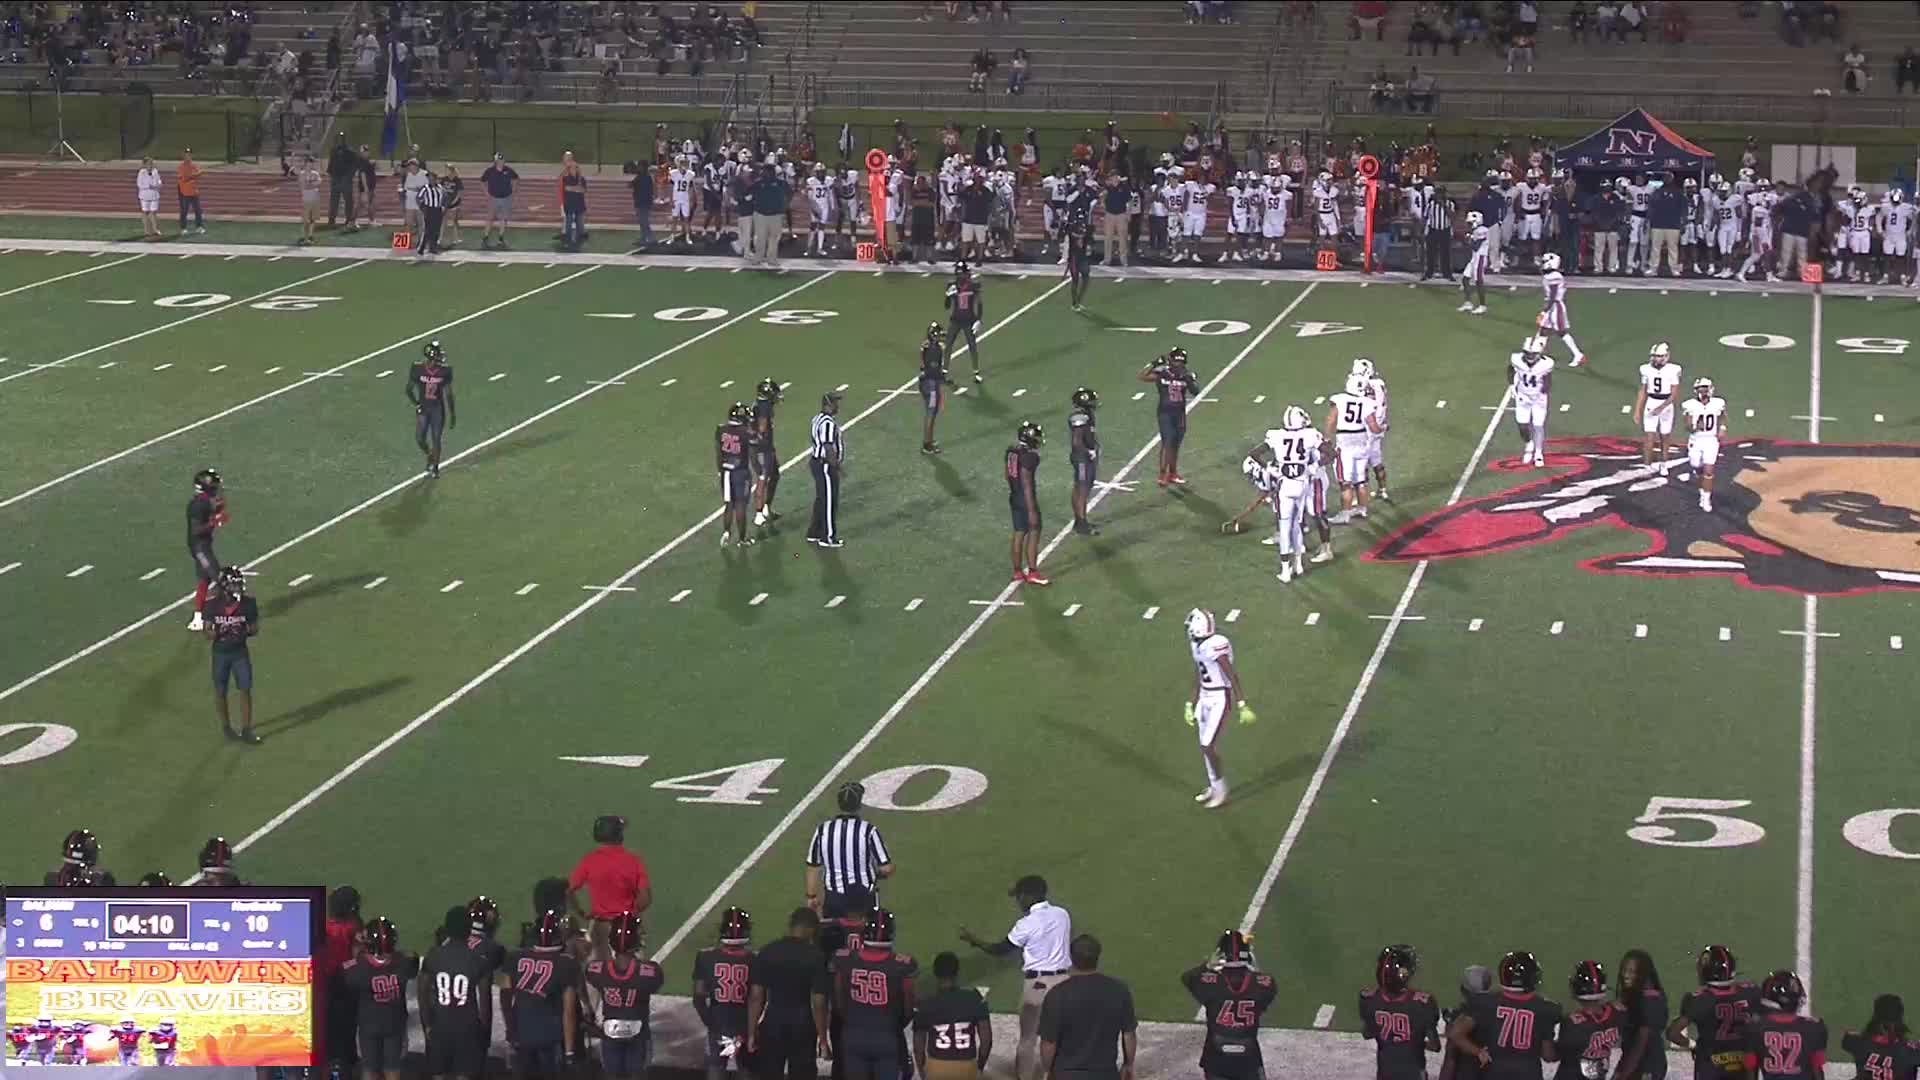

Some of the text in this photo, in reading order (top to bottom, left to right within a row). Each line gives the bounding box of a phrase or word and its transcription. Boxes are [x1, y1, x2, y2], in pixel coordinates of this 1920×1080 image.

[1605, 128, 1657, 156] N
[393, 234, 408, 248] 20
[857, 244, 873, 260] 30
[1317, 253, 1334, 269] 40
[1653, 376, 1662, 394] 9
[1344, 401, 1363, 424] 51
[1282, 437, 1305, 461] 74
[435, 971, 470, 1007] 89
[713, 962, 750, 1004] 38
[850, 968, 889, 1006] 59
[1215, 999, 1257, 1028] 45
[934, 1021, 971, 1050] 35
[1496, 1006, 1536, 1050] 70
